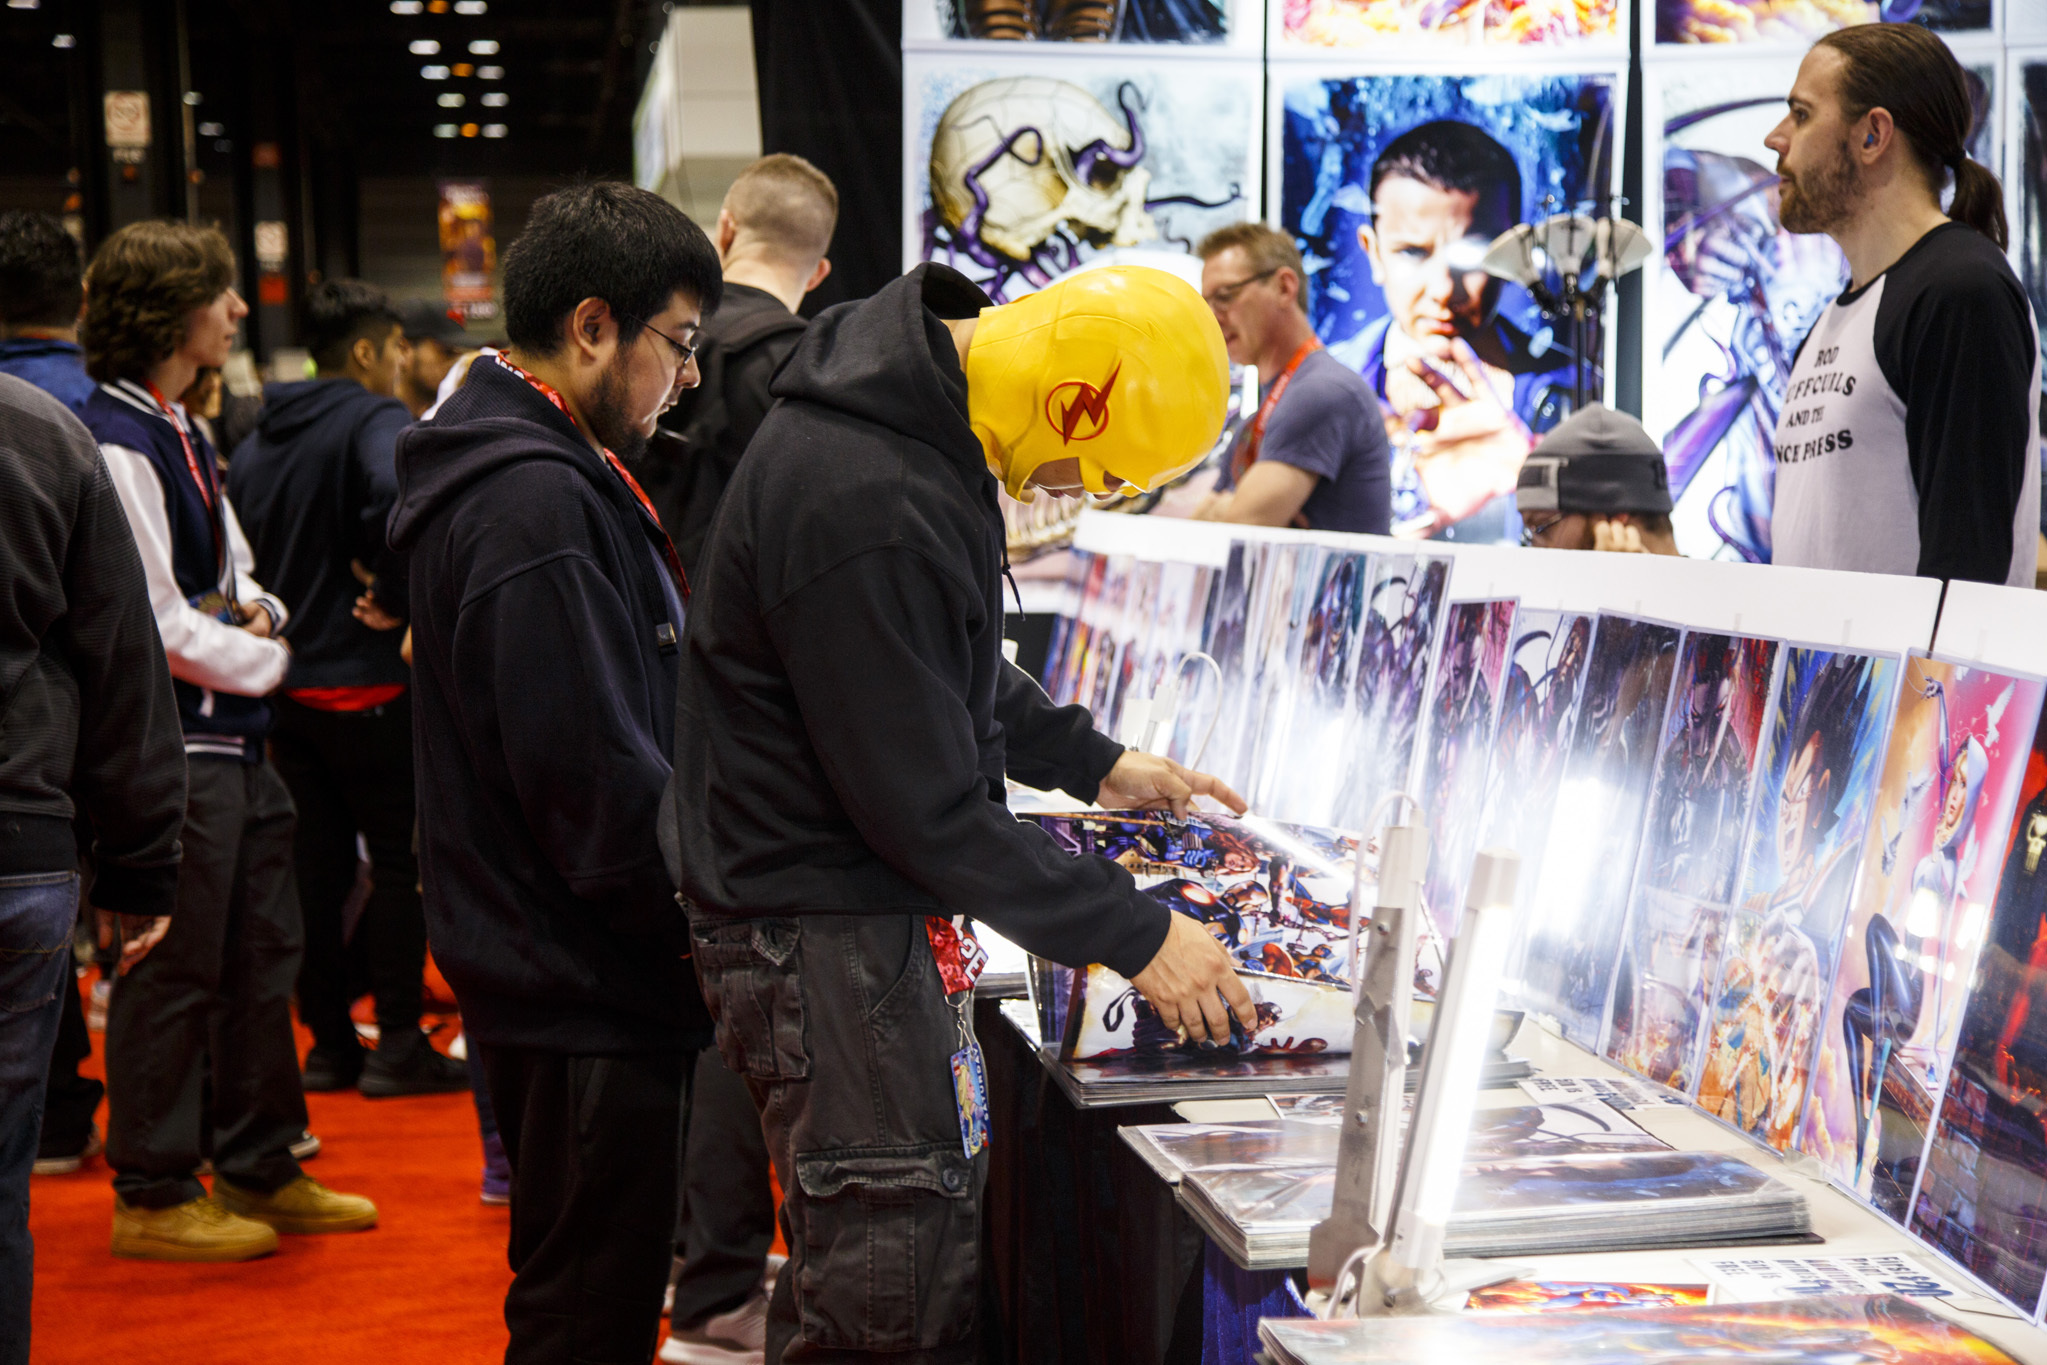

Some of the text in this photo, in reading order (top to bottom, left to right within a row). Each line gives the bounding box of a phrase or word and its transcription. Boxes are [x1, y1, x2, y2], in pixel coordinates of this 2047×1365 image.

[1814, 347, 1839, 368] ROD
[1786, 409, 1810, 428] AND
[1803, 429, 1853, 461] PRESS
[974, 1048, 989, 1121] SATURDAY
